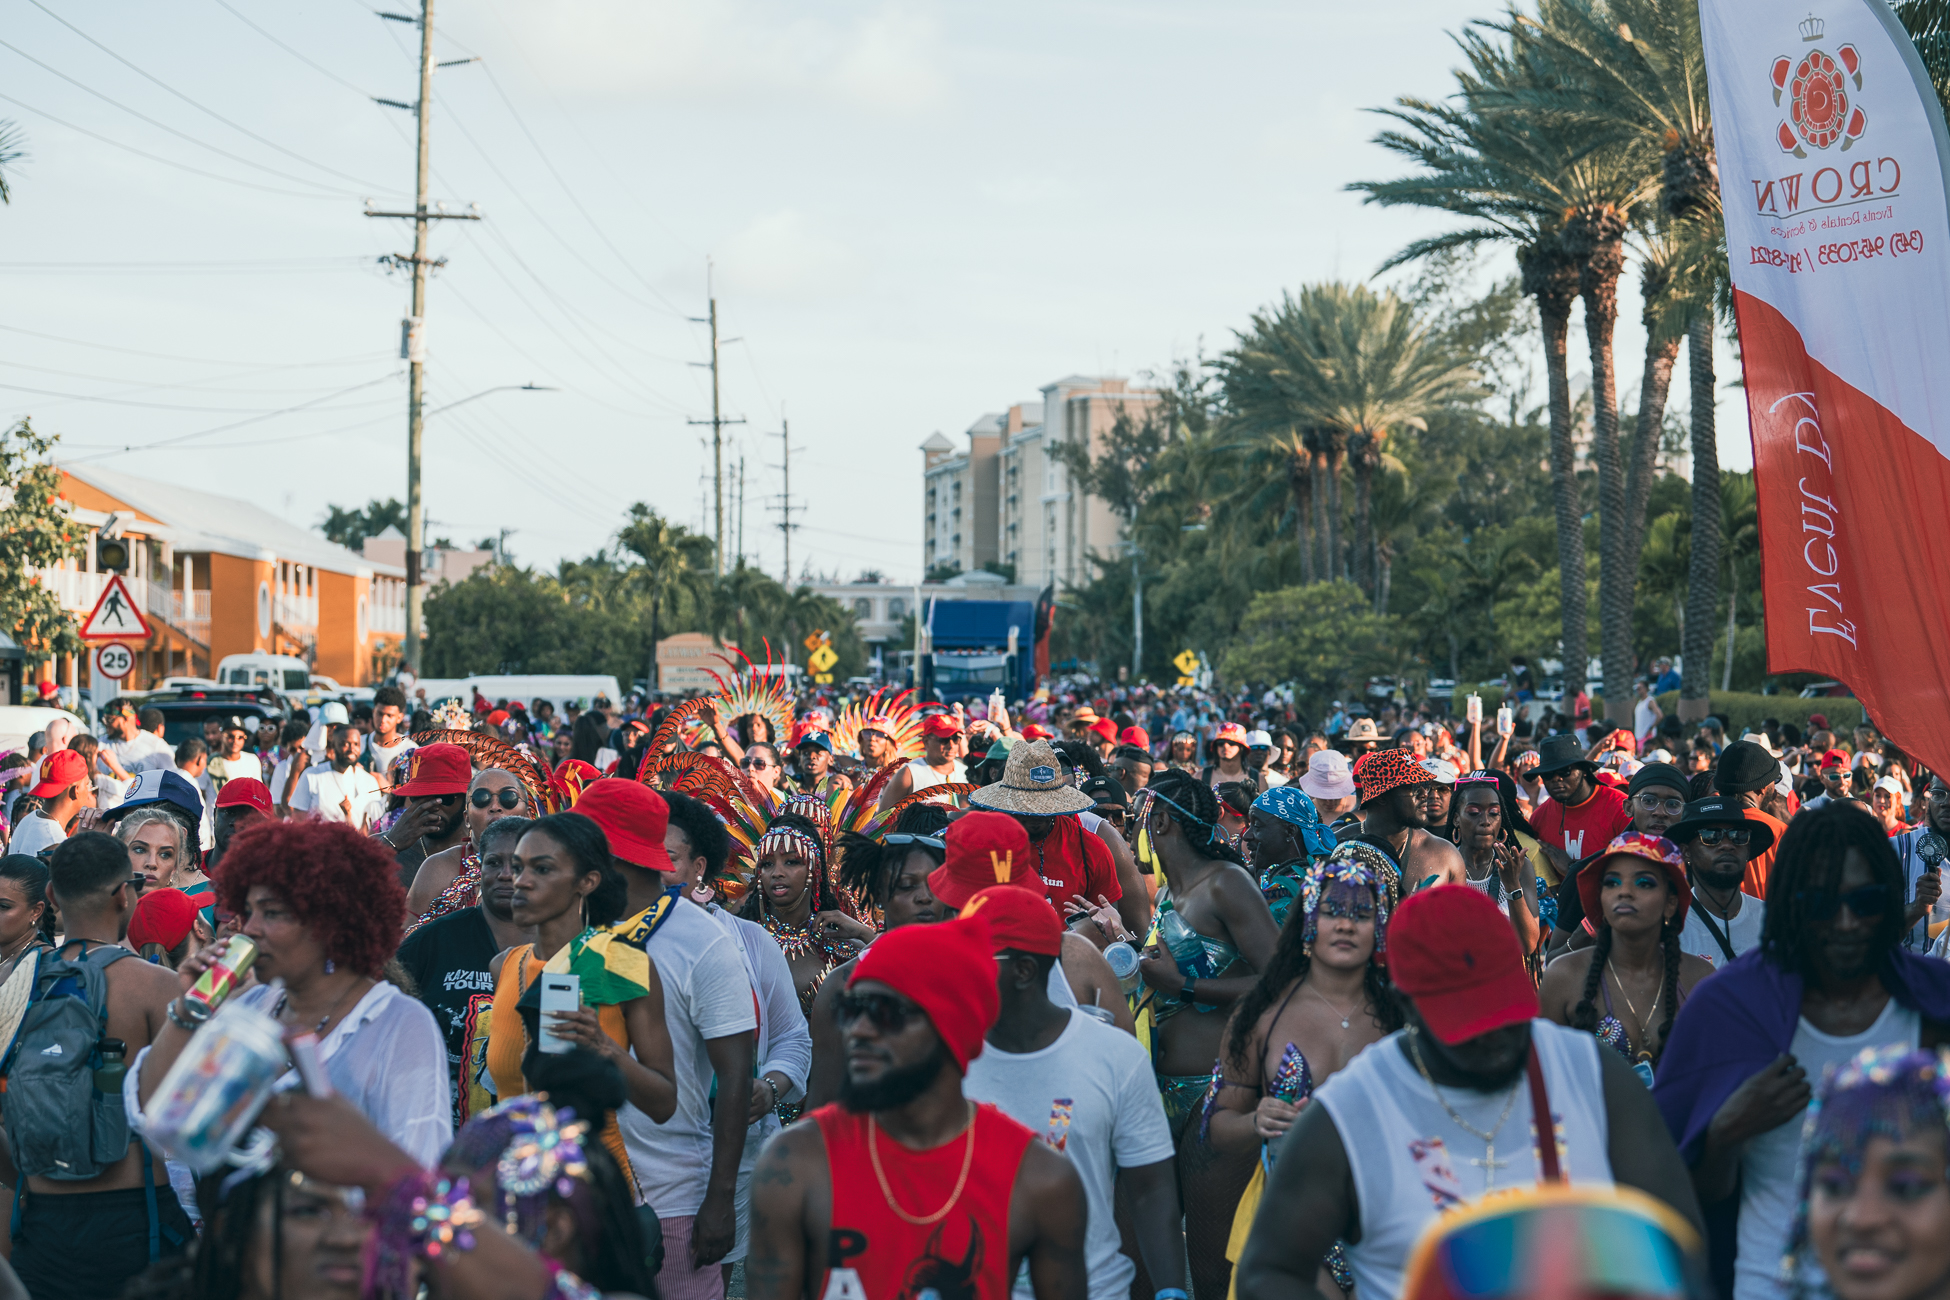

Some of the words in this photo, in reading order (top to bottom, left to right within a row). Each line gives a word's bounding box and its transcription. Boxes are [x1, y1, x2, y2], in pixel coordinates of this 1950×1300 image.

[104, 652, 129, 669] 25
[1564, 829, 1585, 860] W
[989, 849, 1013, 884] W
[443, 968, 475, 983] KAYA
[475, 970, 494, 983] LIVE
[443, 979, 494, 992] TOUR
